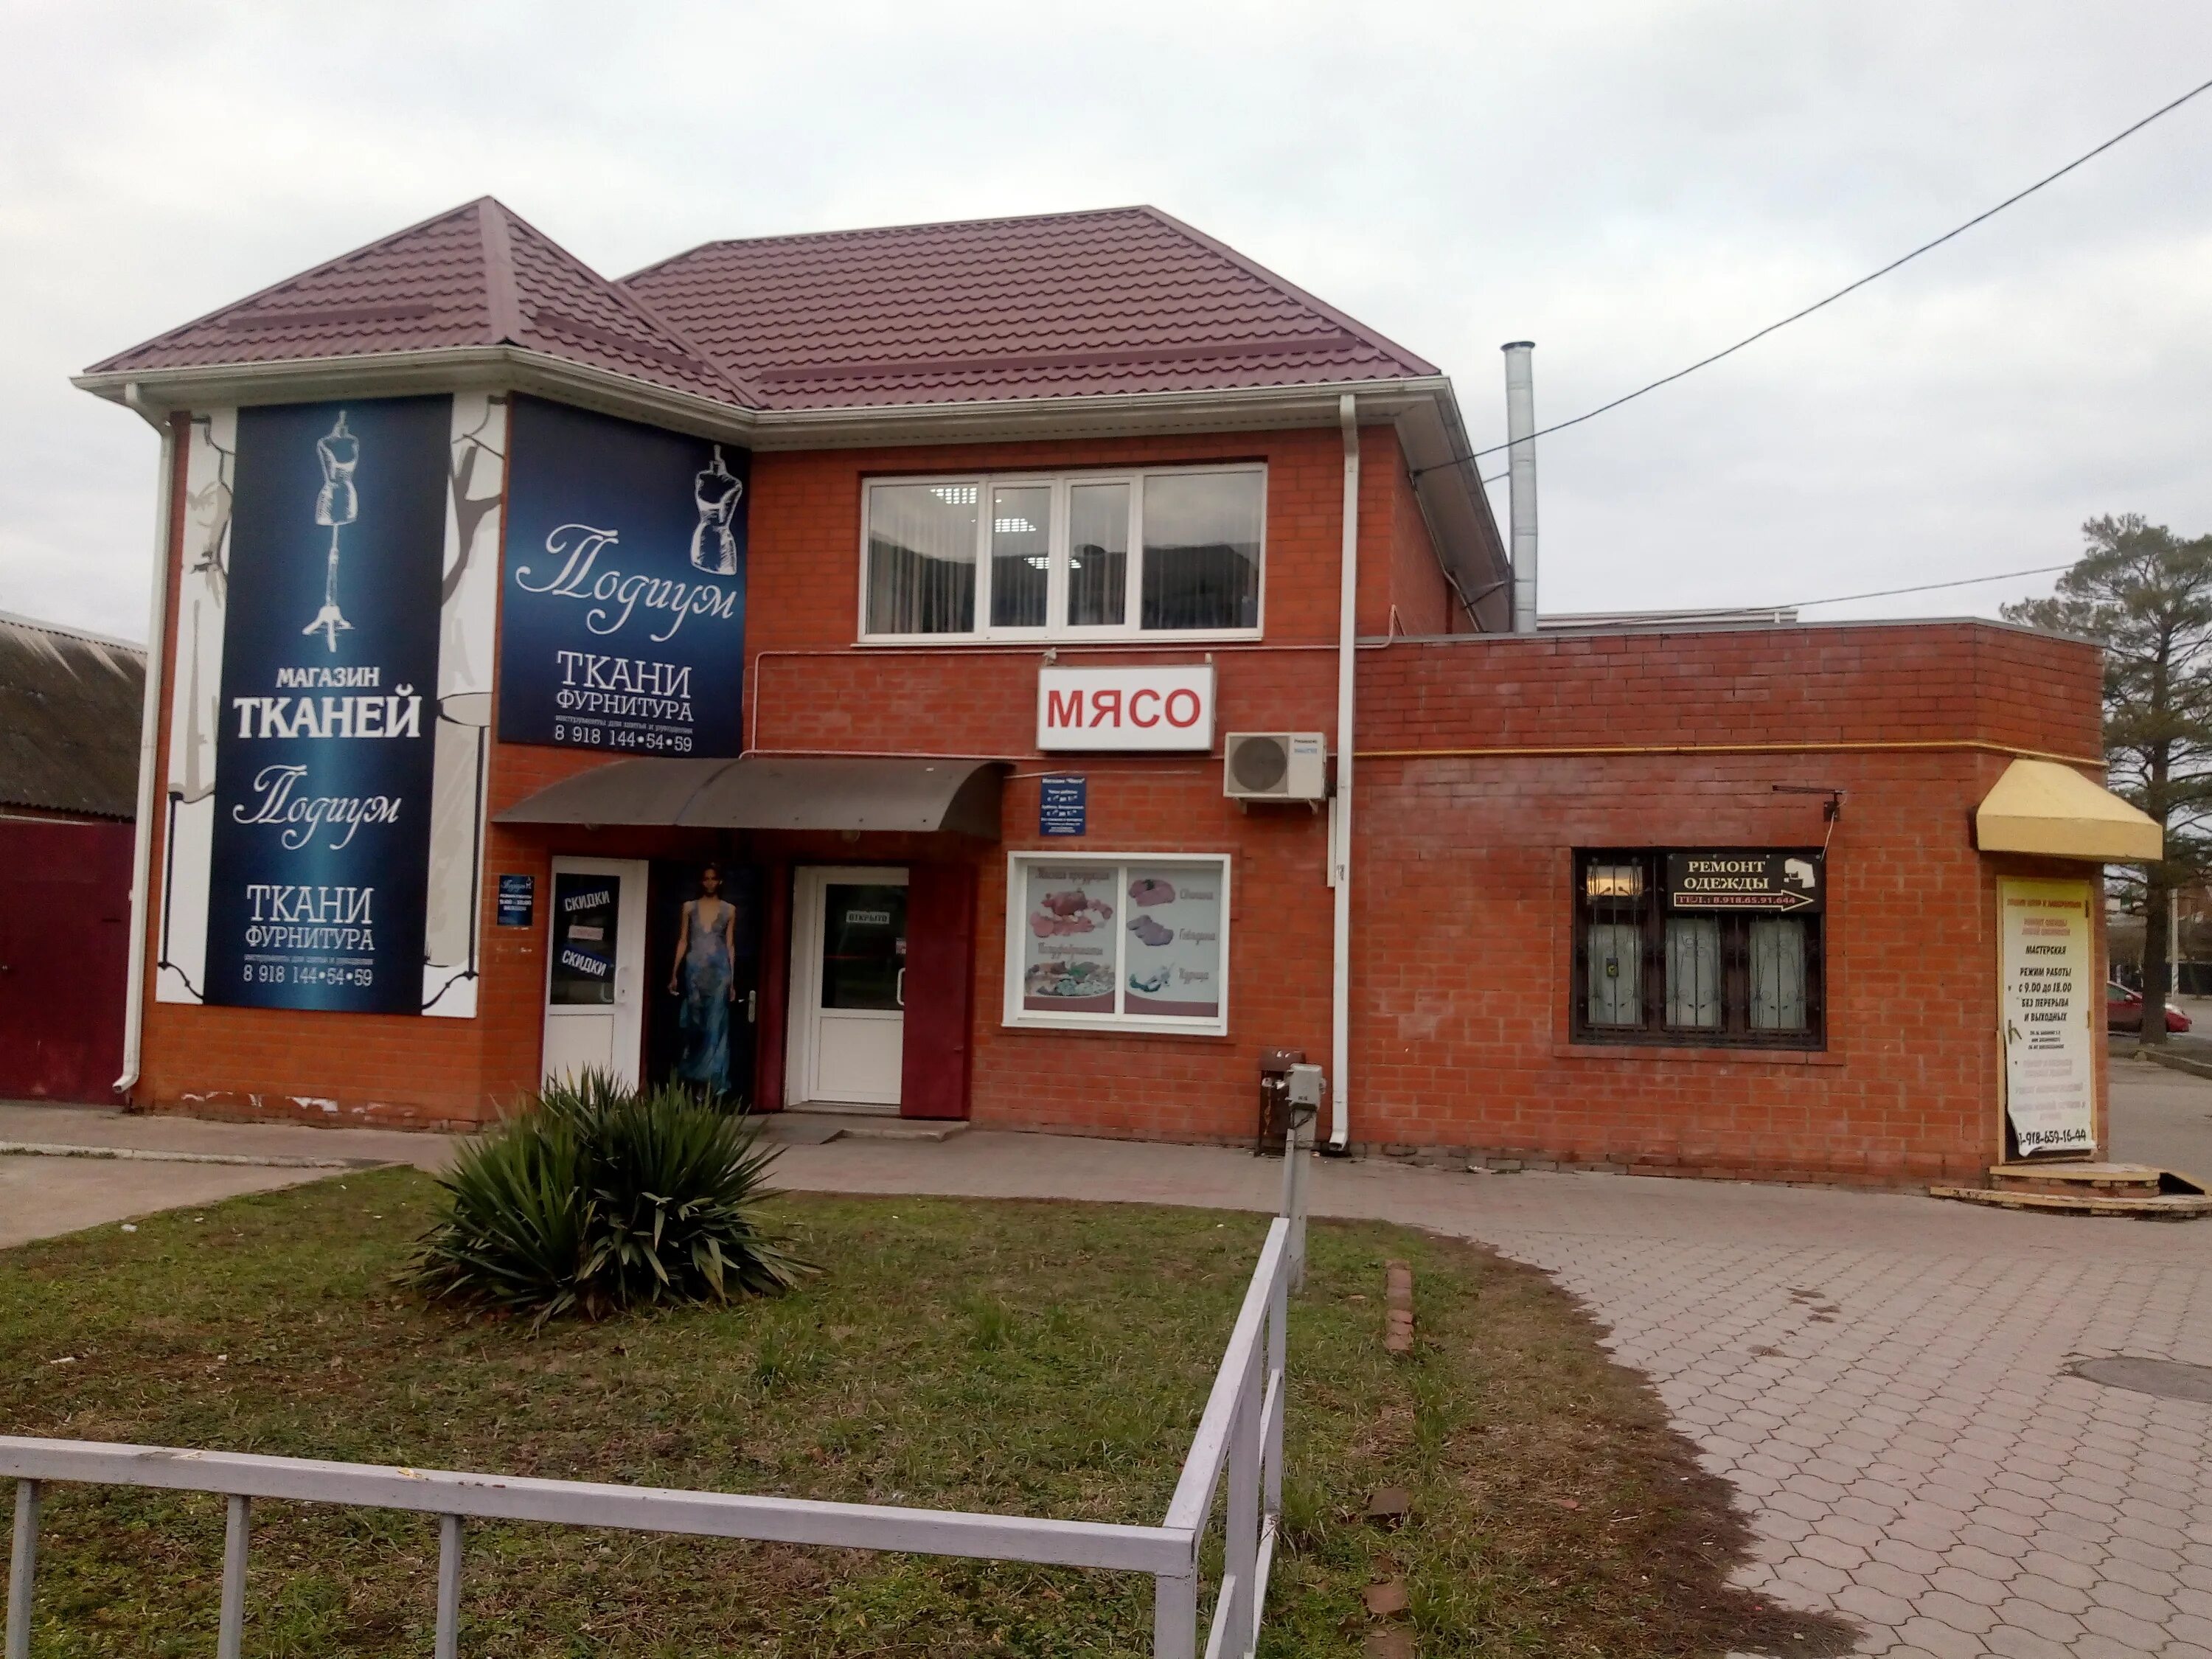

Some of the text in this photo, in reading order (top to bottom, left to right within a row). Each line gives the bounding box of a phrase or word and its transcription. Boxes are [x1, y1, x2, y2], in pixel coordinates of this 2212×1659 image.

[515, 524, 737, 642] Подиум
[275, 667, 380, 688] МАГАЗИН
[557, 650, 692, 698] ТКАНИ
[232, 684, 422, 738] ТКАНЕЙ
[556, 689, 694, 722] ФУРНИТУРА
[1047, 689, 1200, 728] МЯСО
[554, 724, 565, 741] 8
[572, 726, 601, 745] 918
[232, 764, 402, 849] Подиум
[1688, 860, 1766, 872] РЕМОНТ
[1683, 877, 1769, 891] ОДЕЖДЫ
[247, 885, 375, 925] ТКАНИ
[564, 891, 611, 911] СКИДКИ
[246, 925, 375, 950] ФУРНИТУРА
[2025, 945, 2067, 955] МАСТЕРСКАЯ
[562, 950, 607, 976] СКИДКИ
[2020, 967, 2072, 976] РЕЖИМ РАБОТЫ
[243, 964, 253, 982] 8
[259, 964, 285, 984] 918
[2025, 982, 2041, 993] 9.00
[2042, 984, 2051, 993] до
[2053, 982, 2072, 992] 18.00
[2022, 998, 2069, 1007] БЕЗ ПЕРЕРЫВА
[2024, 1012, 2067, 1022] И ВЫХОДНЫХ
